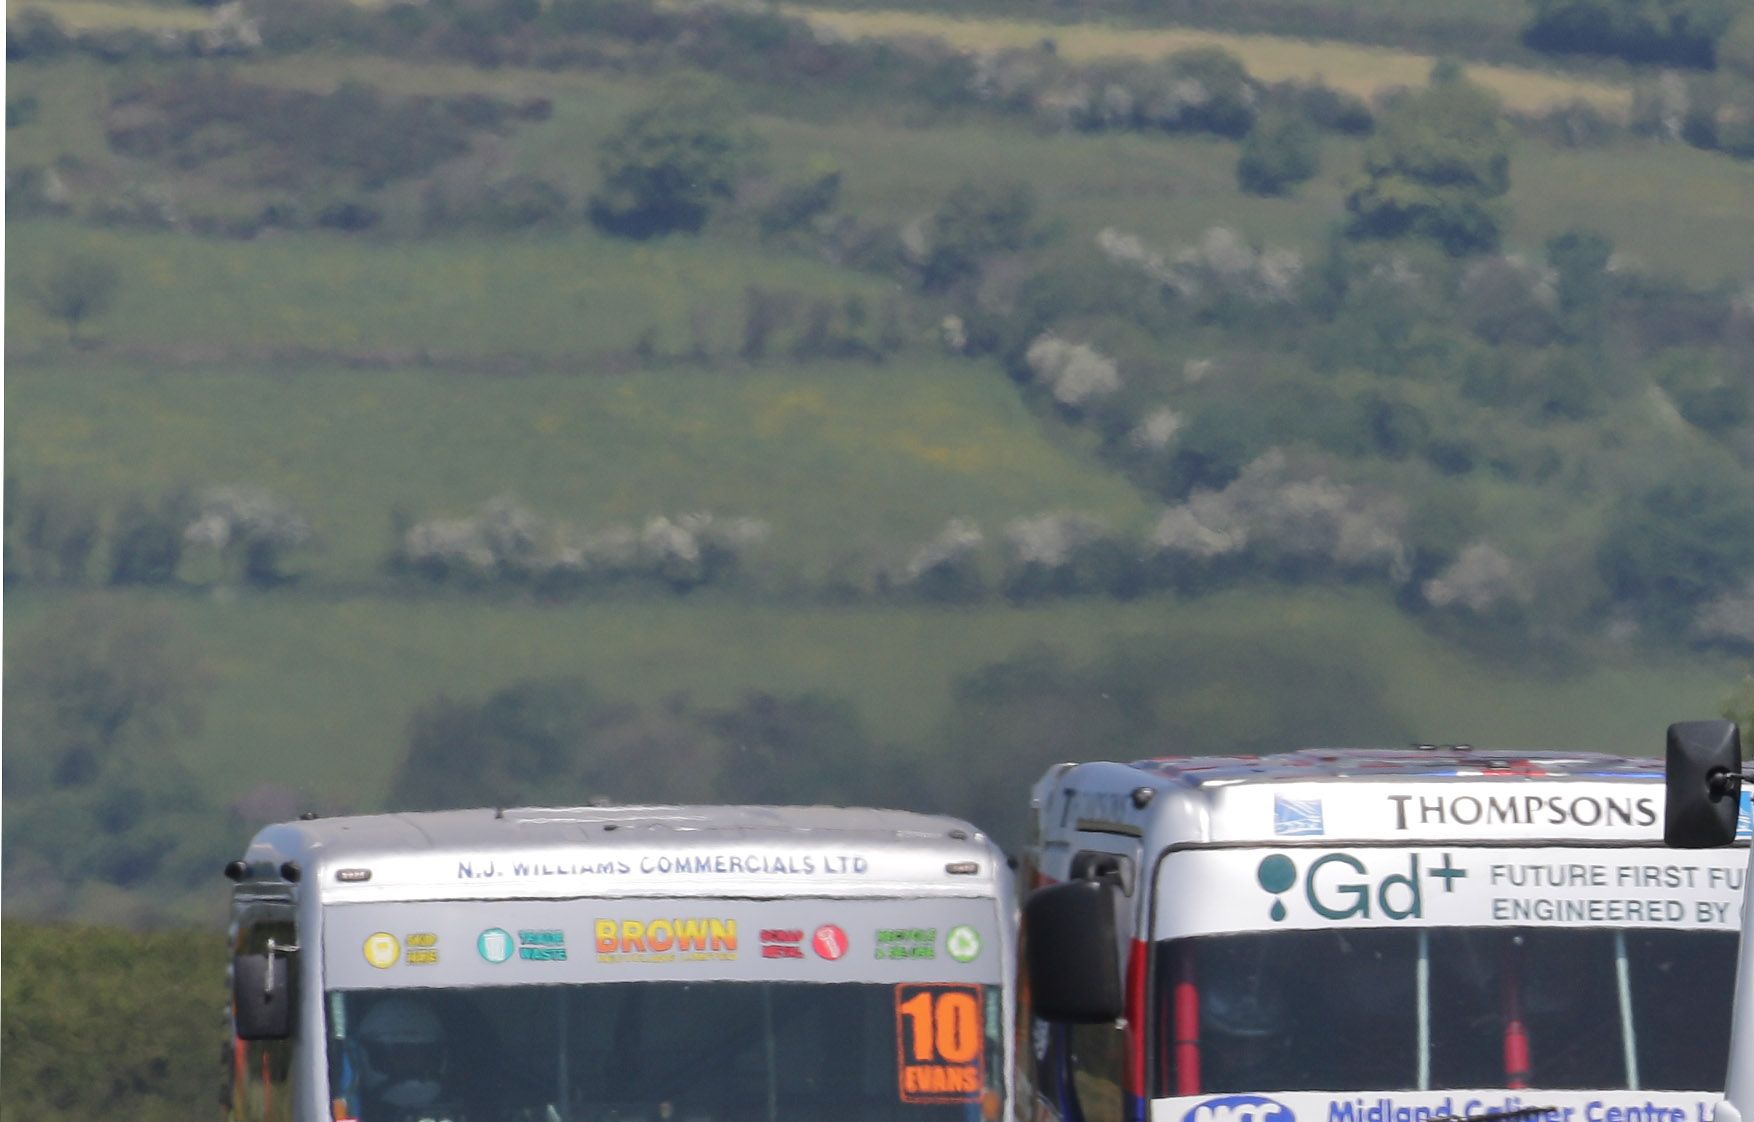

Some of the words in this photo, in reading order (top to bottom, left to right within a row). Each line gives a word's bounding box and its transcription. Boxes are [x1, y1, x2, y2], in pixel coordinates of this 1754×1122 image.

[1388, 794, 1657, 830] THOMPSONS
[457, 860, 503, 879] N.J.
[512, 859, 631, 876] WILLIAMS
[640, 855, 816, 875] COMMERCIALS
[824, 855, 868, 875] LTD
[1490, 864, 1610, 888] FUTURE
[1617, 865, 1699, 890] FIRST
[1493, 898, 1685, 924] ENGINEERED
[1696, 901, 1731, 925] BY
[594, 917, 738, 953] BROWN
[900, 991, 979, 1063] 10
[904, 1064, 978, 1093] EVANS
